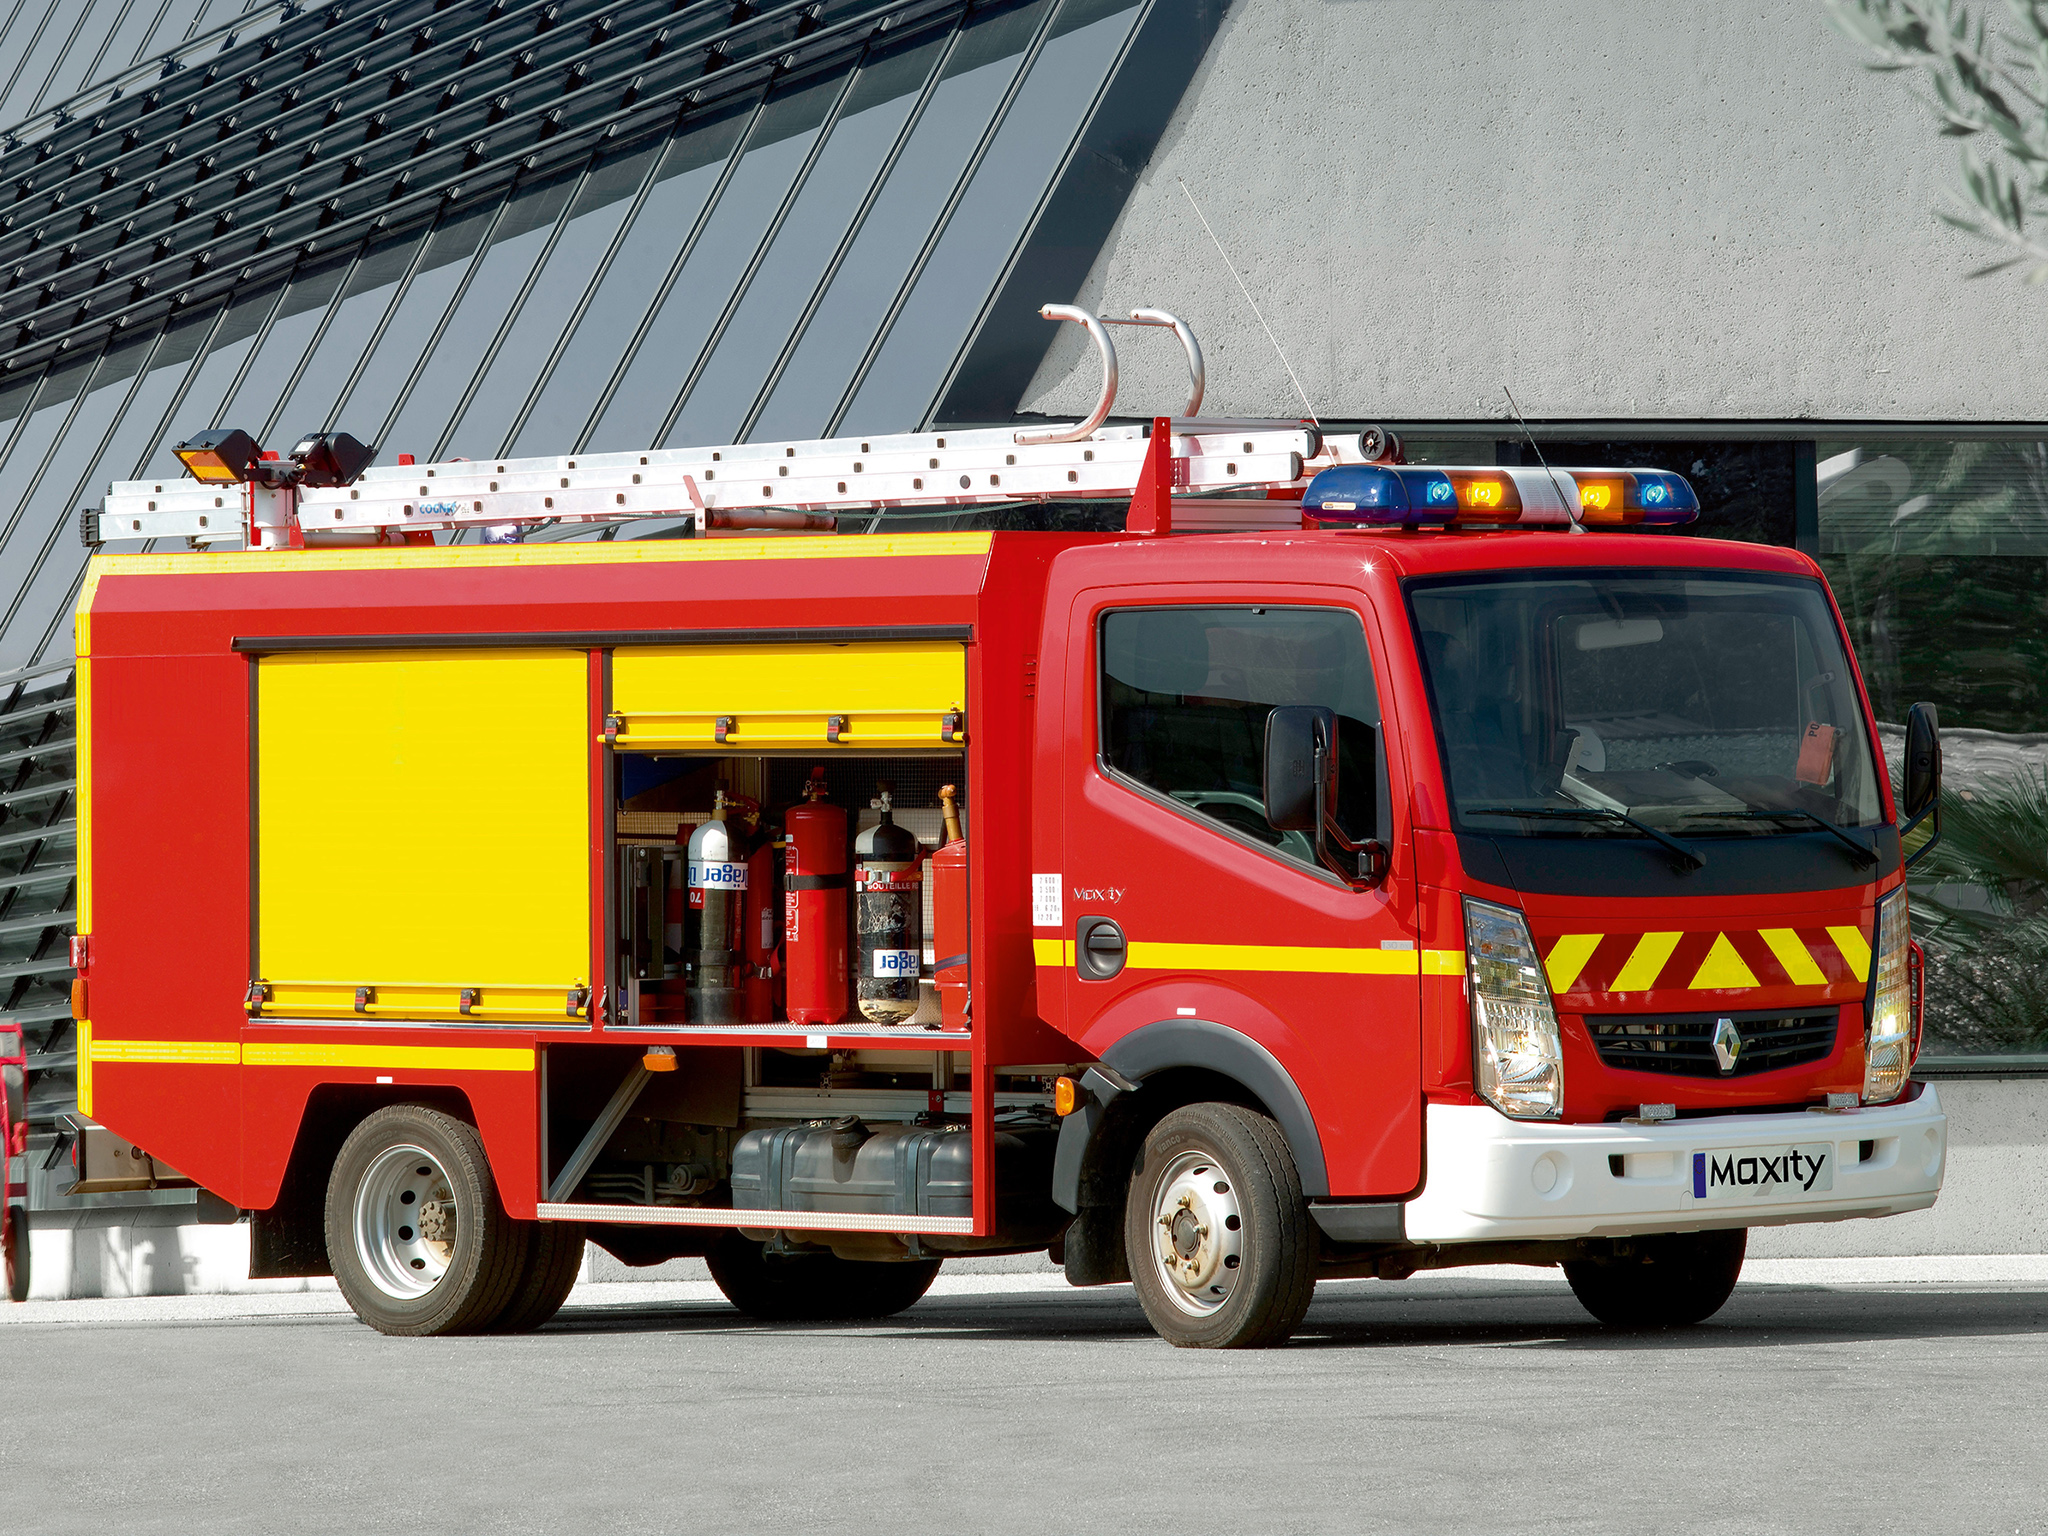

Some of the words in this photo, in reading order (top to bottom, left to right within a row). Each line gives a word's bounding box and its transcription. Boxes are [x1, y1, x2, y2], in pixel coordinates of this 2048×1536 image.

[690, 892, 702, 904] 70
[1073, 887, 1126, 904] Maxity
[879, 951, 919, 974] räger
[1710, 1149, 1826, 1192] Maxity
